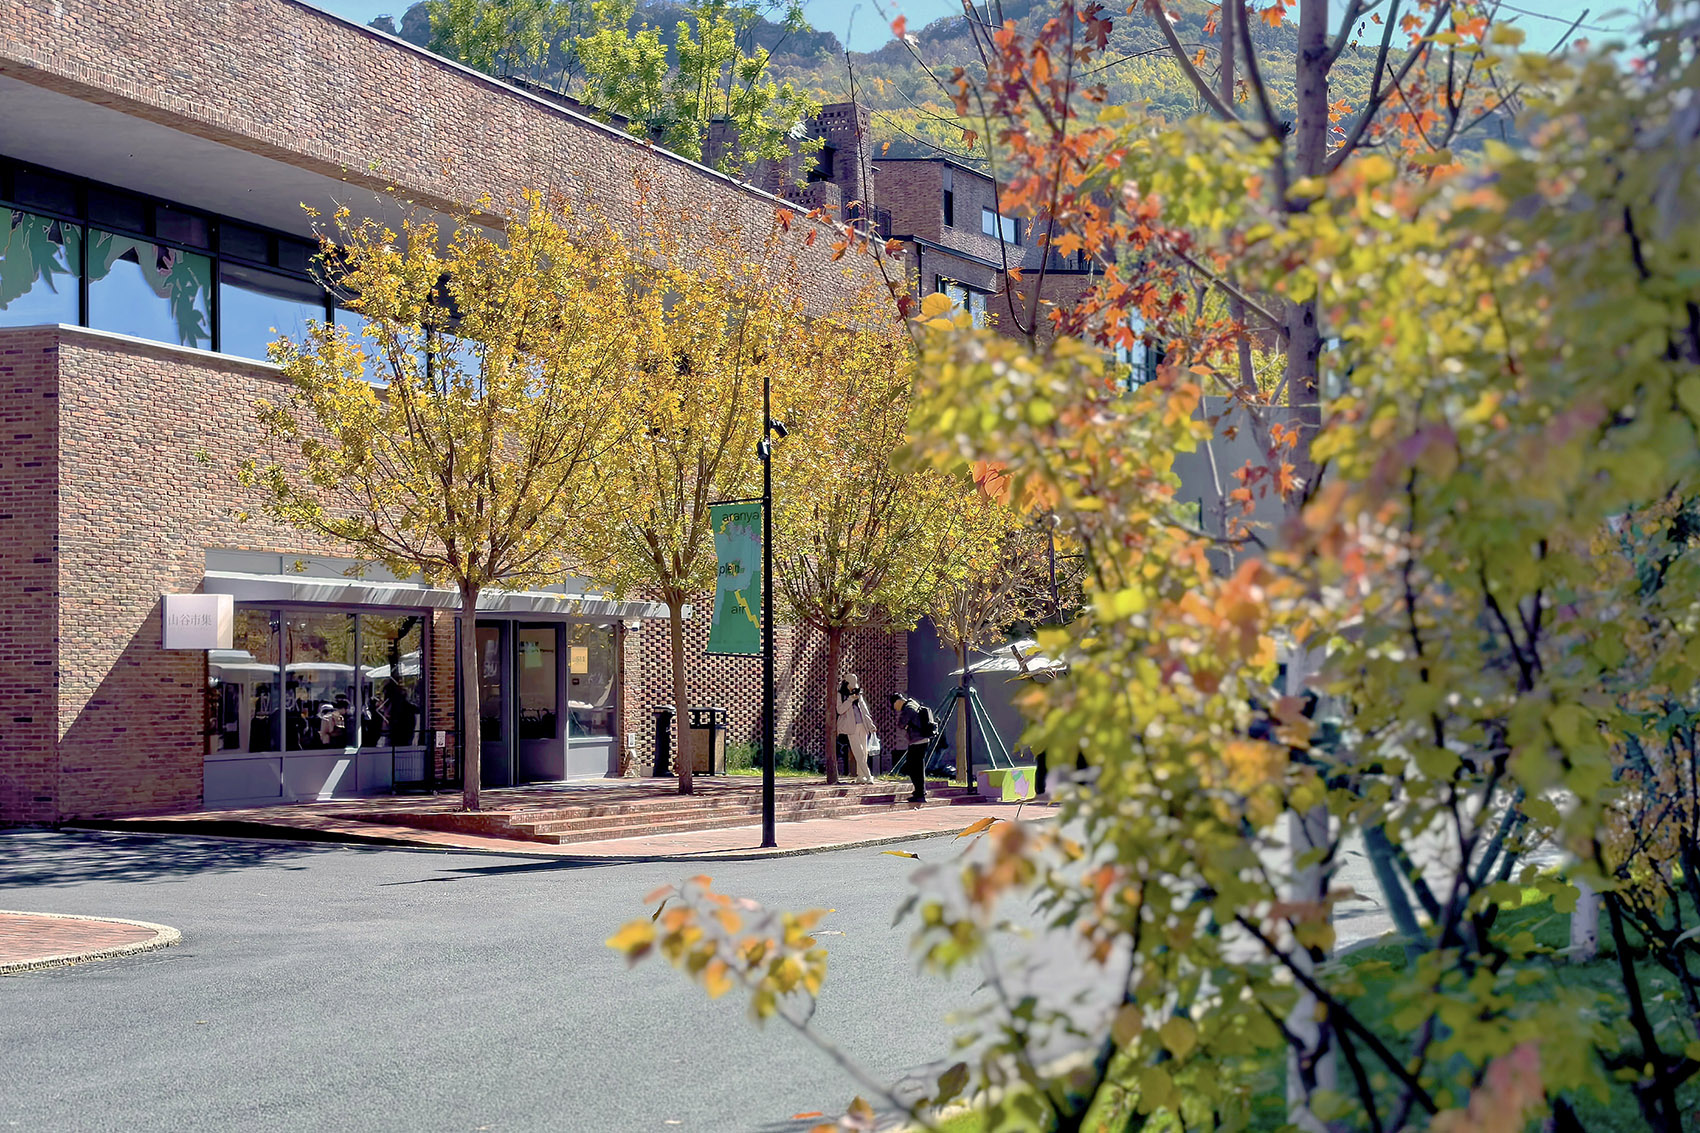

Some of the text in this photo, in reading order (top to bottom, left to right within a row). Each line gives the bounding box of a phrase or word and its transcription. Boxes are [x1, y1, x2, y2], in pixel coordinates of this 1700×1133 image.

[722, 511, 760, 523] aranya
[731, 603, 746, 614] air
[168, 613, 212, 626] 山谷市集
